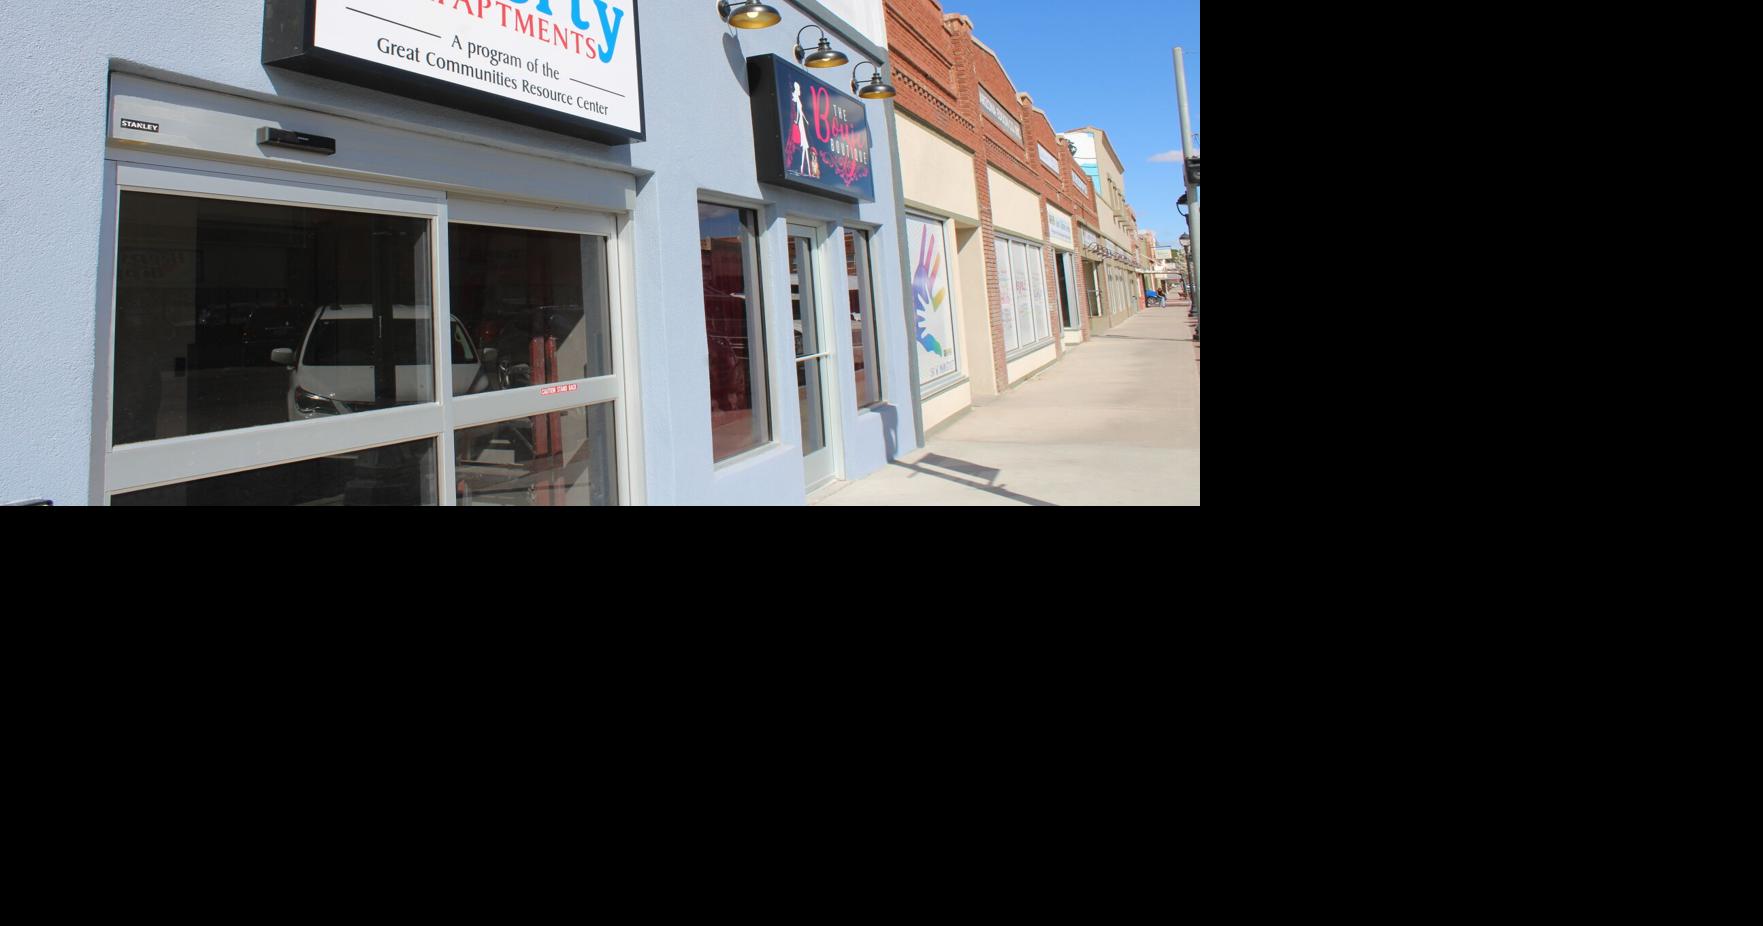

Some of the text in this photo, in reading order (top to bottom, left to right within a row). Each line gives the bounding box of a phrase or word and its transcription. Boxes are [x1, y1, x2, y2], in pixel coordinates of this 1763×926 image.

[451, 34, 560, 80] A program of the
[377, 37, 609, 116] Great Communities Resource Center
[121, 120, 158, 131] STANLEY
[832, 104, 847, 122] THE
